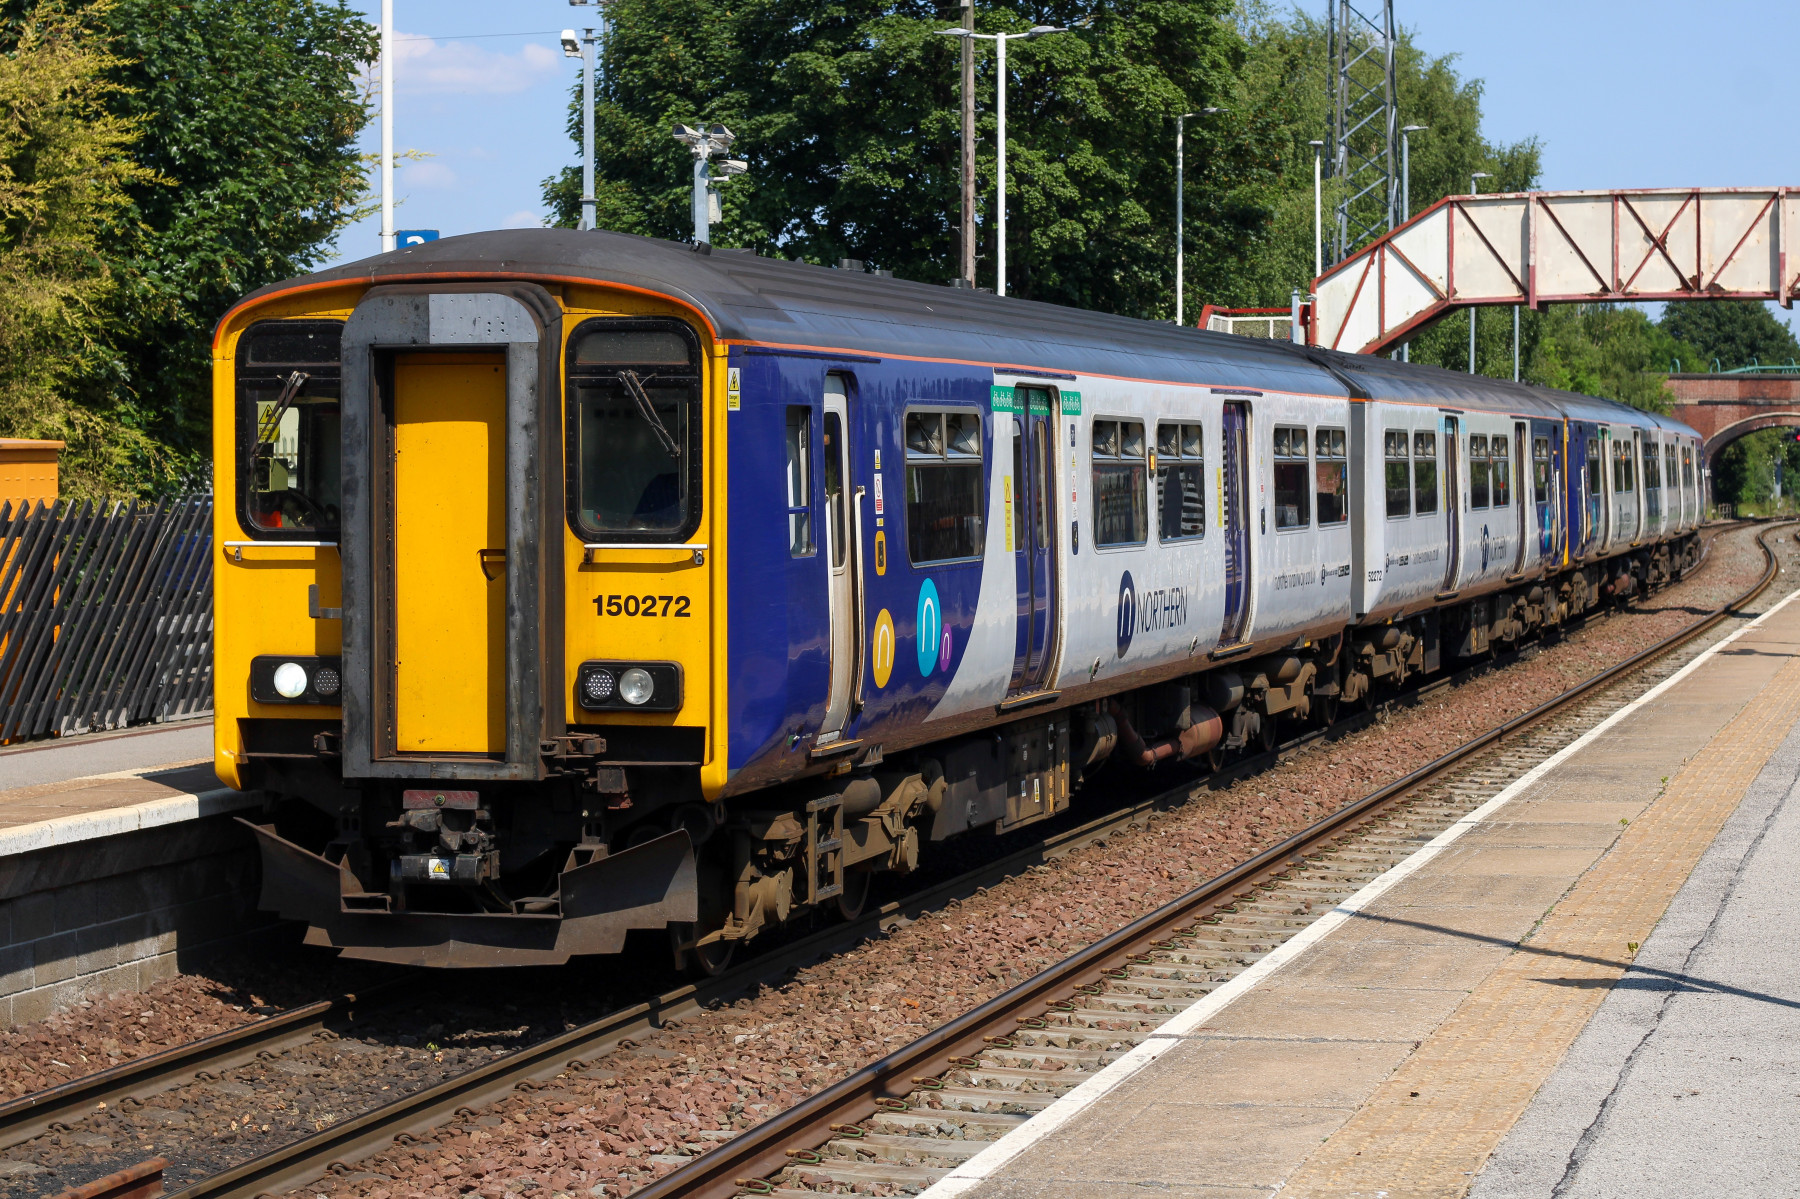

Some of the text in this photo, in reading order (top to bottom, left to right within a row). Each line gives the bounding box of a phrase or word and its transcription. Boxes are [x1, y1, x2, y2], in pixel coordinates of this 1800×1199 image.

[1367, 570, 1382, 582] 52272
[592, 594, 691, 617] 150272
[1136, 585, 1188, 634] NORTHERN
